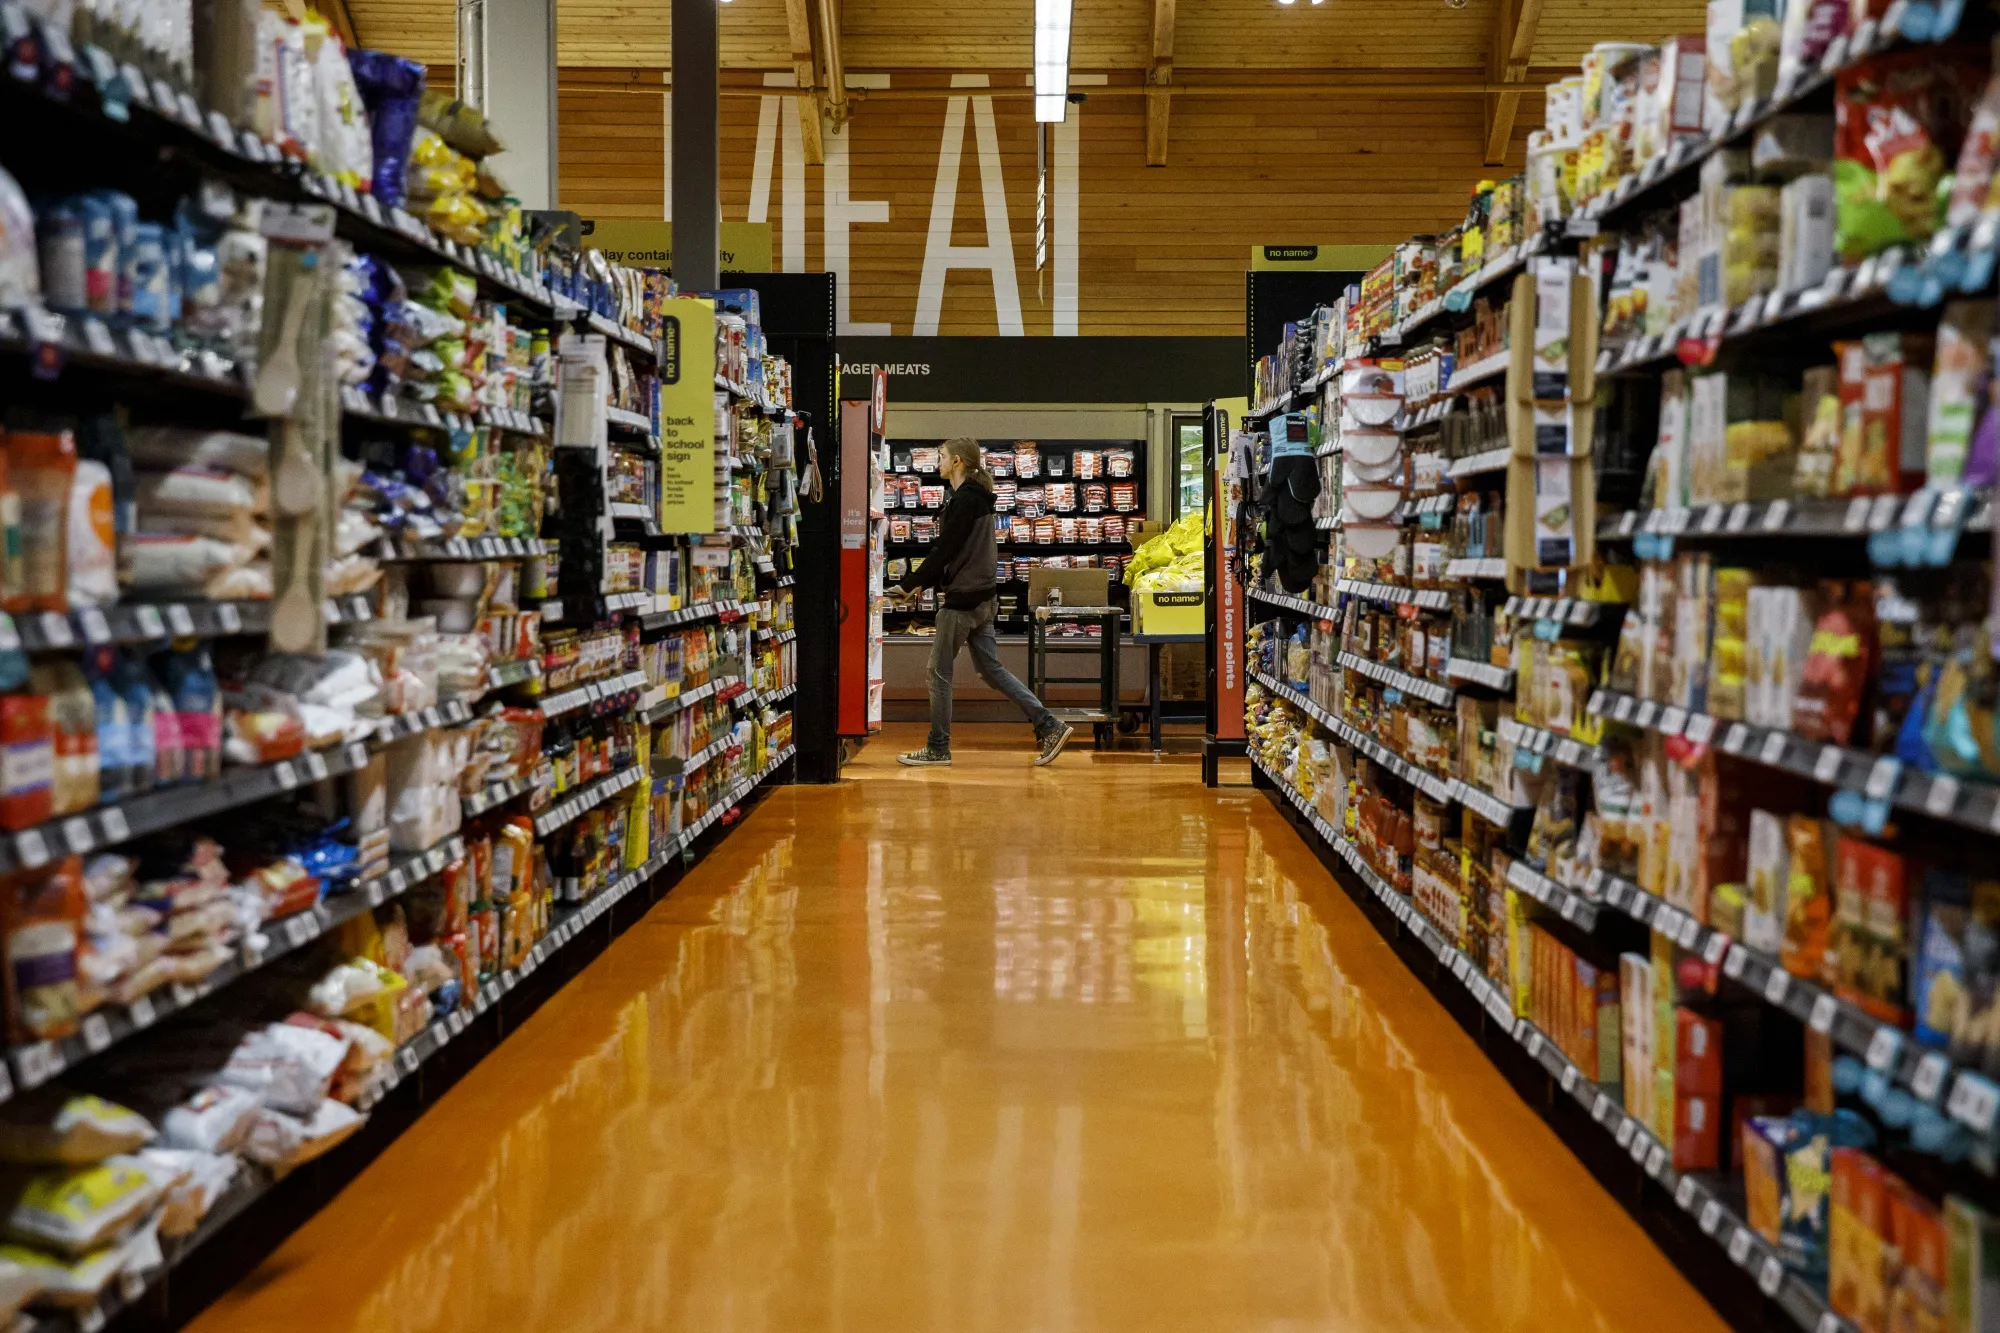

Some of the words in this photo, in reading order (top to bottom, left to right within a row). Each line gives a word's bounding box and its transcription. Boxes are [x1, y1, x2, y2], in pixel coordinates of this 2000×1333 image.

[601, 249, 624, 262] lay
[628, 250, 672, 261] contai
[719, 250, 735, 264] ity
[667, 363, 675, 379] no
[884, 363, 931, 375] MEATS
[666, 417, 695, 426] back
[666, 429, 678, 437] to
[667, 440, 705, 449] school
[1221, 439, 1227, 449] no
[667, 452, 691, 463] sign
[847, 509, 861, 517] It's
[1224, 608, 1235, 640] love
[1223, 642, 1236, 690] points
